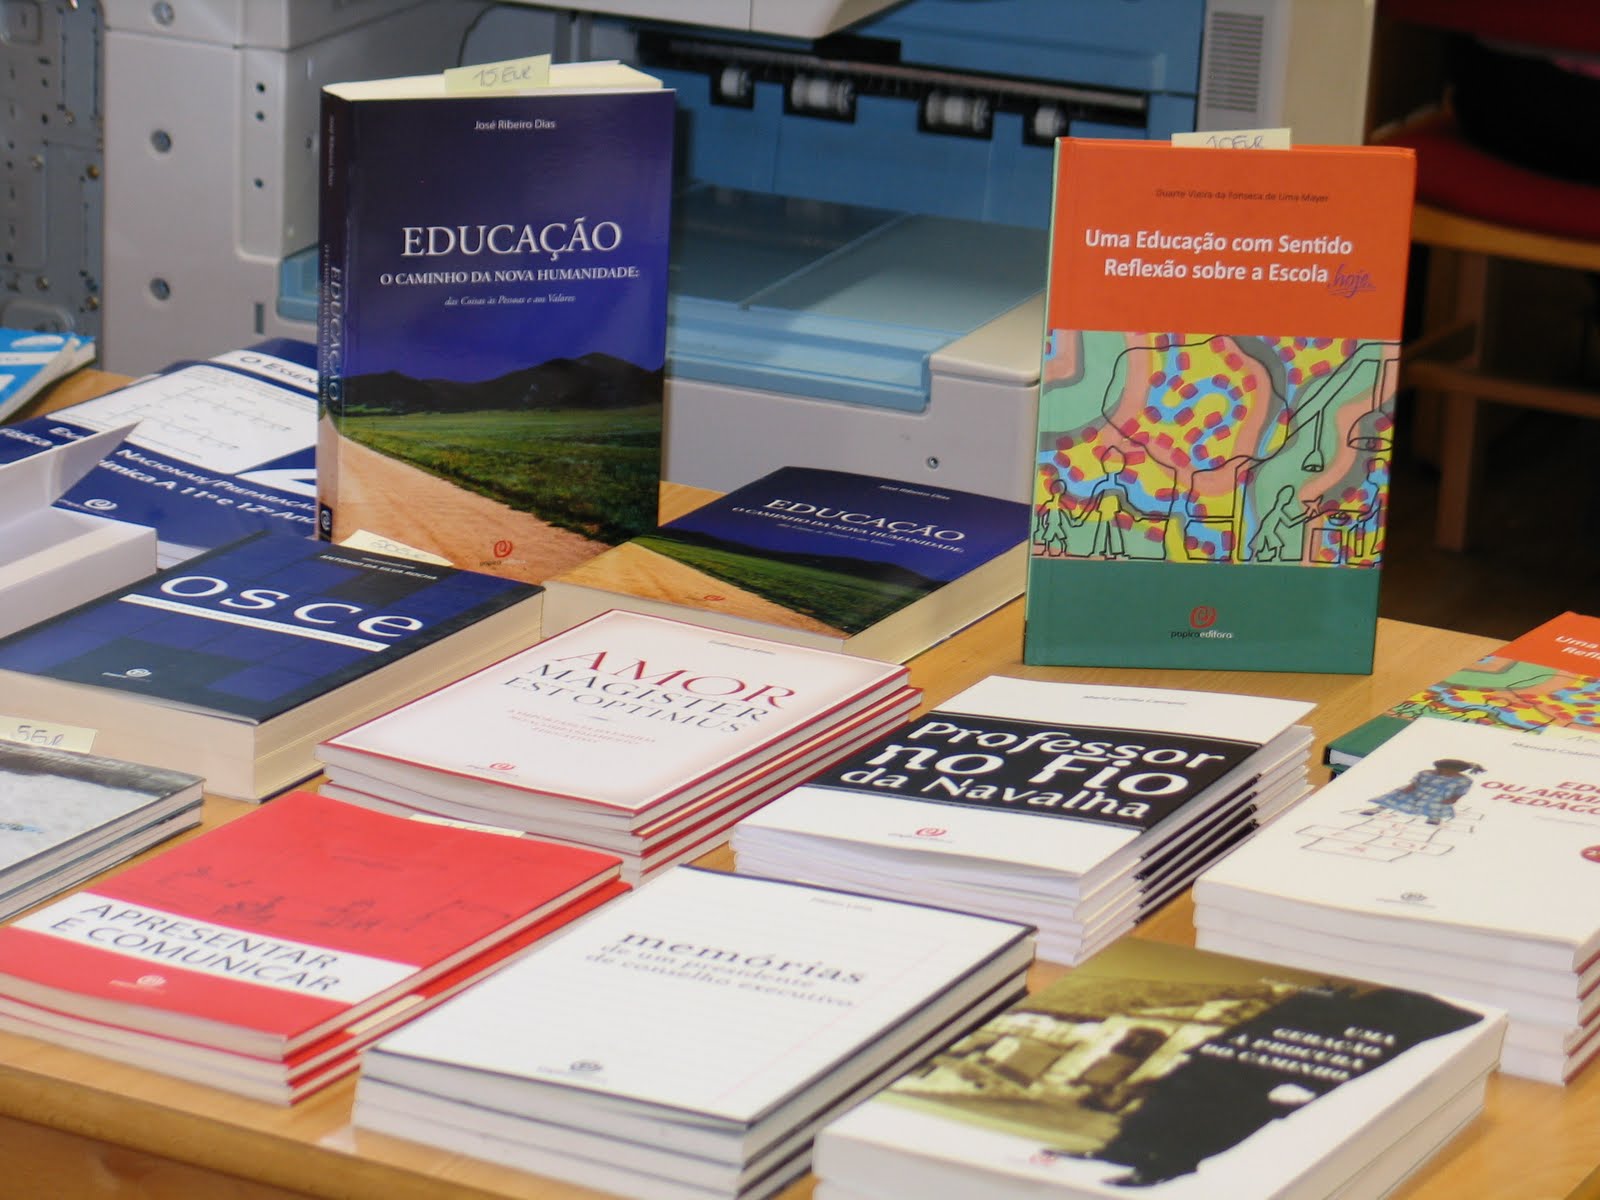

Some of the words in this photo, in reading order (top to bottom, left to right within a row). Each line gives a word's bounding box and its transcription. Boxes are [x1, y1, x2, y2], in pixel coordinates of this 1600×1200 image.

[473, 119, 496, 131] José
[497, 119, 533, 130] Ribeiro
[534, 118, 556, 130] Dias
[1156, 188, 1186, 199] Duarte
[1188, 189, 1213, 199] Vieira
[1214, 190, 1226, 200] da
[1228, 190, 1263, 201] Fonseca
[1265, 190, 1277, 201] de
[1278, 191, 1300, 202] Lima
[1301, 193, 1329, 204] Mayer
[401, 217, 622, 261] EDUCAÇÃO
[1085, 229, 1130, 248] Uma
[1136, 231, 1227, 254] Educação
[1231, 236, 1273, 252] com
[1278, 234, 1353, 255] Sentido
[380, 273, 393, 285] O
[395, 271, 467, 286] CAMINHO
[471, 270, 492, 283] DA
[494, 268, 533, 283] NOVA
[537, 265, 641, 281] HUMANIDADE:
[1104, 258, 1187, 279] Reflexão
[1192, 261, 1246, 281] sobre
[1251, 266, 1263, 281] a
[1269, 263, 1328, 283] Escola
[547, 292, 577, 303] Valores
[153, 480, 177, 491] A
[215, 498, 234, 506] e
[745, 508, 810, 525] CAMINHO
[810, 520, 830, 529] DA
[831, 524, 867, 535] NOVA
[763, 498, 966, 542] EDUCAÇÃO
[1555, 635, 1599, 649] Uma
[528, 663, 770, 722] MAGISTER
[552, 650, 796, 708] AMOR
[504, 676, 574, 696] EST
[572, 693, 748, 733] OPTIMUS
[907, 721, 1226, 770] Professor
[865, 744, 1005, 775] no
[1028, 753, 1189, 797] Fio
[1556, 781, 1600, 794] ED
[840, 767, 910, 788] da
[920, 774, 1152, 819] Navalha
[1480, 781, 1526, 793] OU
[1526, 788, 1600, 805] ARM
[79, 903, 339, 970] APRESENTAR
[50, 916, 75, 932] E
[87, 925, 341, 993] COMUNICAR
[620, 932, 866, 984] memórias
